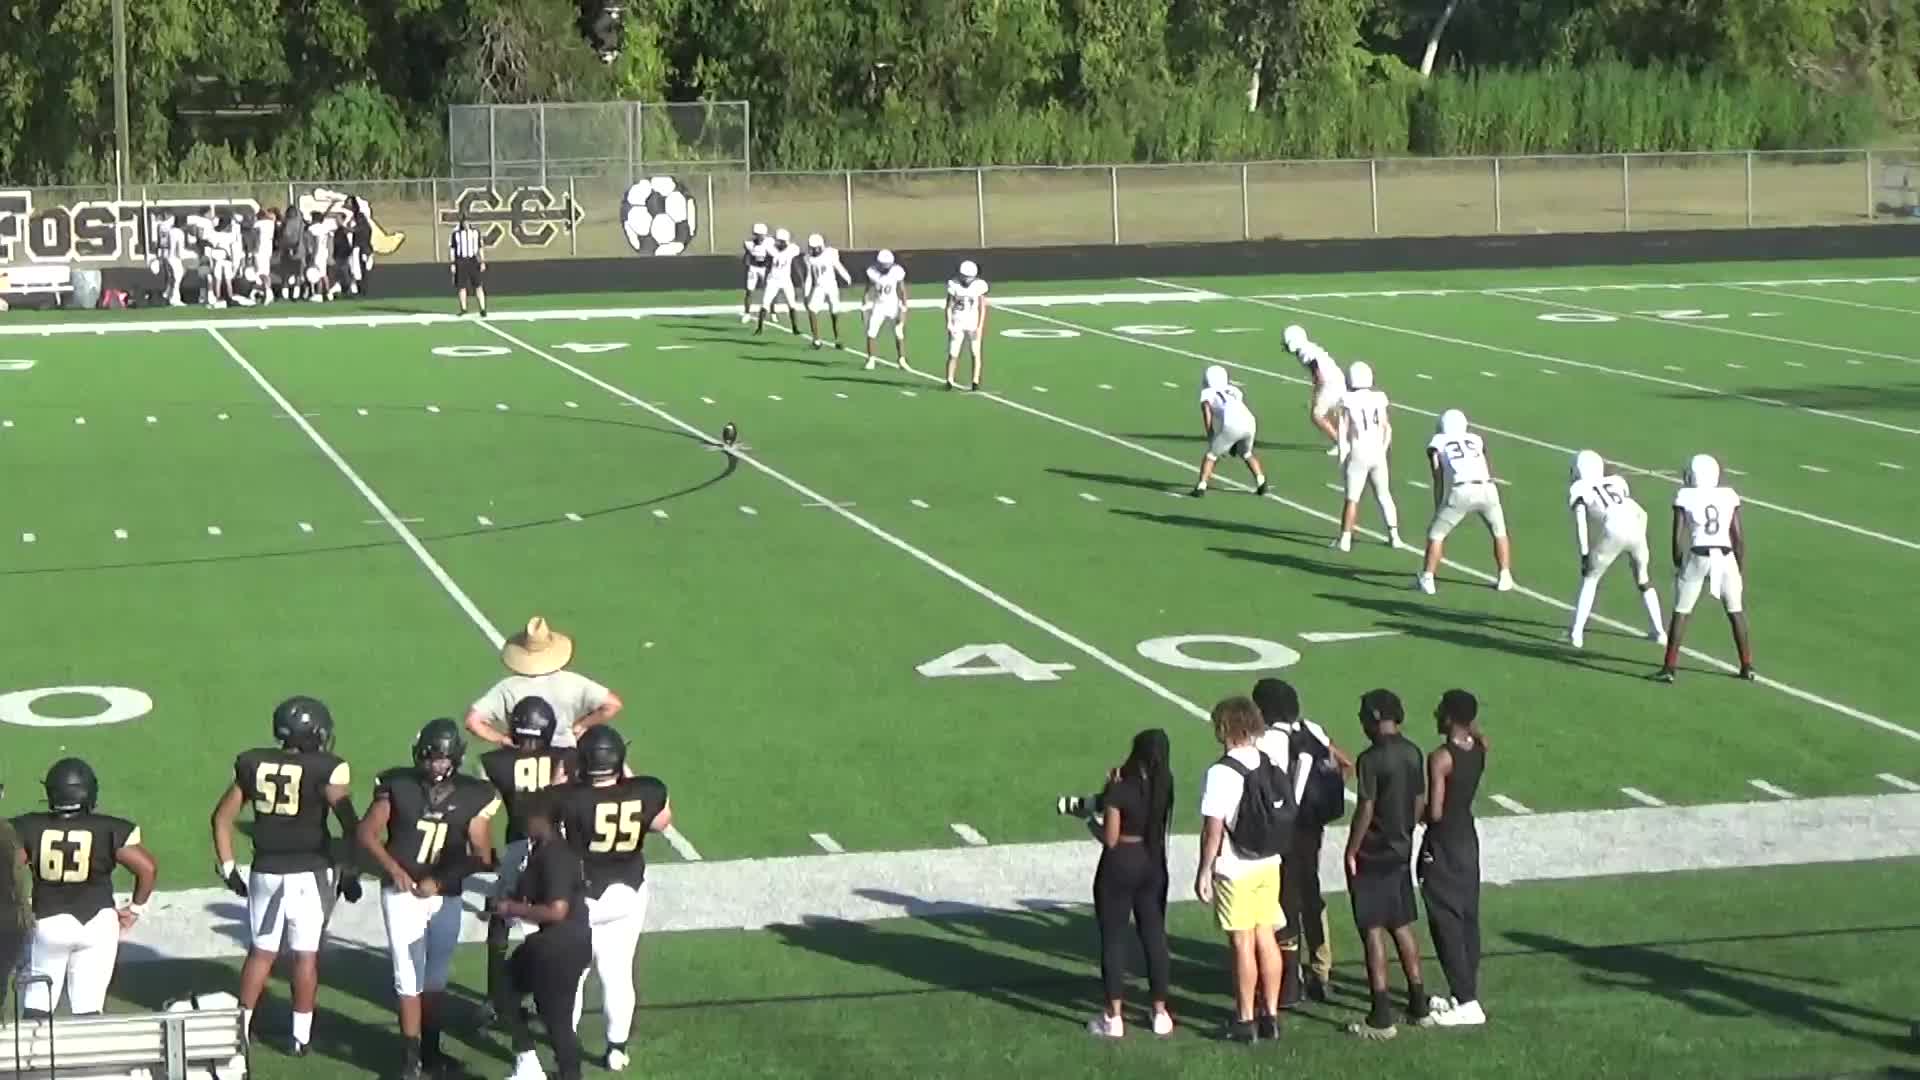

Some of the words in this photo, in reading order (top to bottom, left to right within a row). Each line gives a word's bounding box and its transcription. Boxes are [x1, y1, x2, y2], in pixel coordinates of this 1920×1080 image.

[1592, 483, 1623, 508] 16
[1704, 504, 1720, 536] 8
[255, 762, 303, 816] 53
[416, 820, 449, 864] 71
[588, 799, 642, 853] 55
[39, 829, 93, 883] 63
